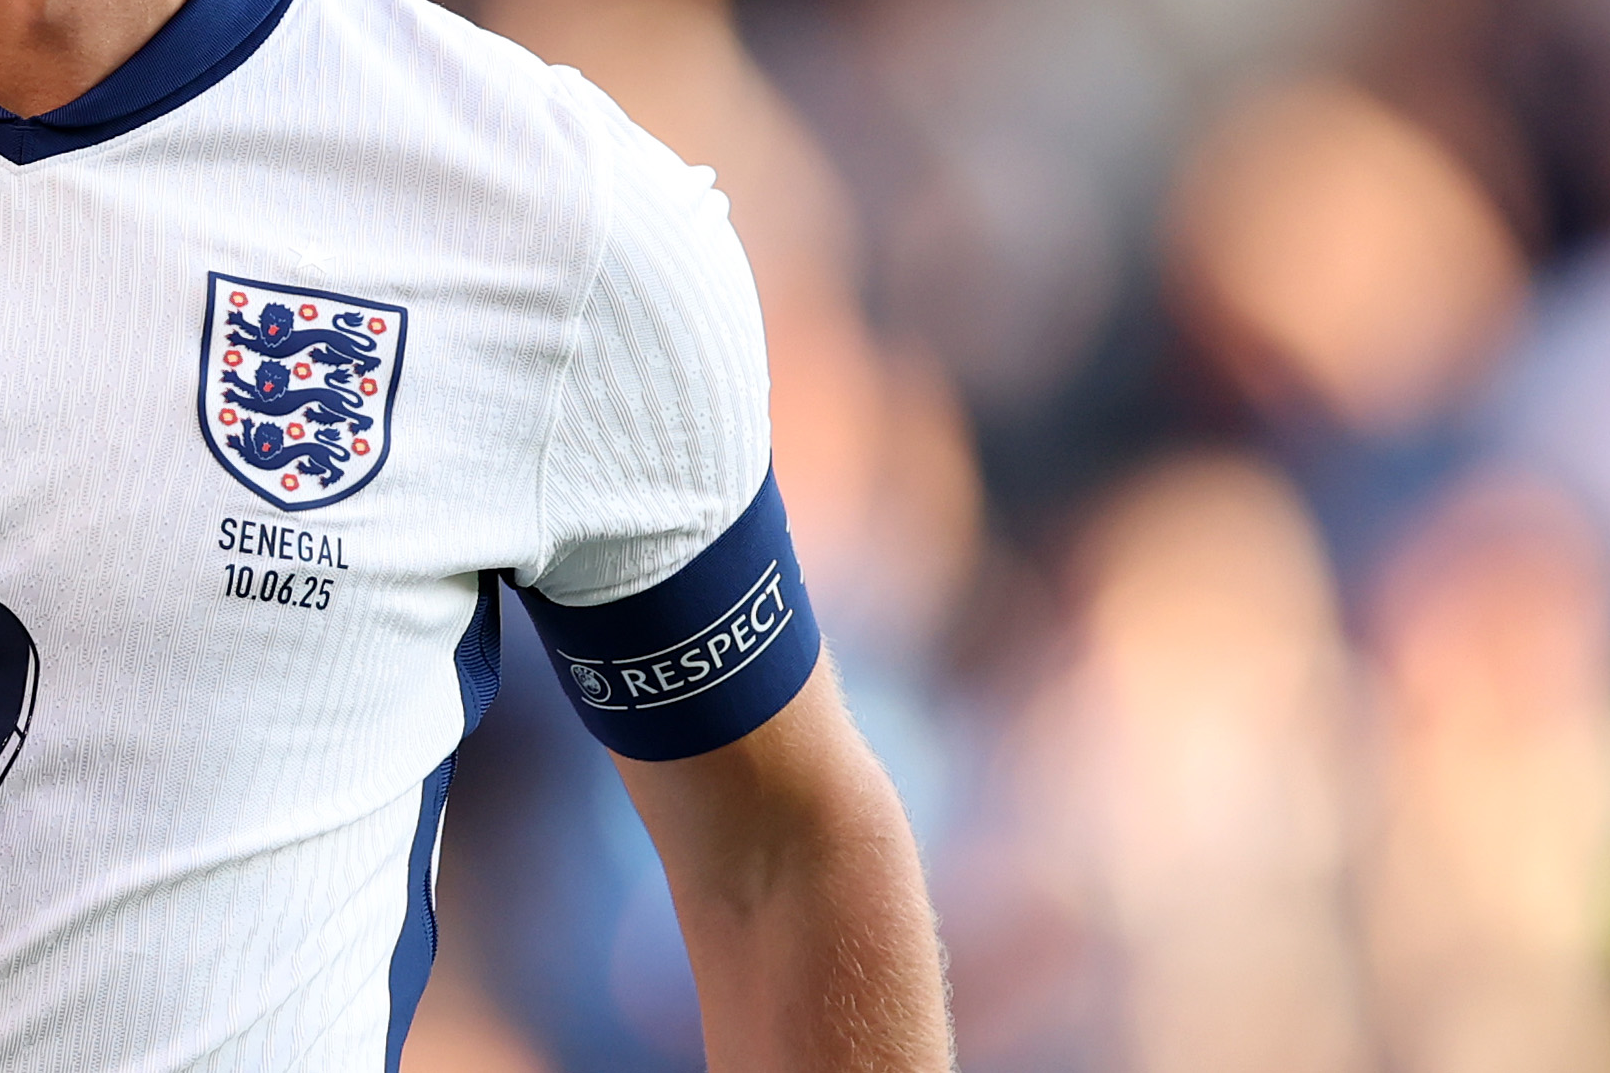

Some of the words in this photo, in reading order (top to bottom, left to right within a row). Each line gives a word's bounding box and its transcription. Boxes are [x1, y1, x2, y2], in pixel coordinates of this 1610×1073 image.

[219, 518, 349, 569] SENEGAL
[225, 564, 334, 610] 10.06.25
[621, 573, 785, 697] RESPECT
